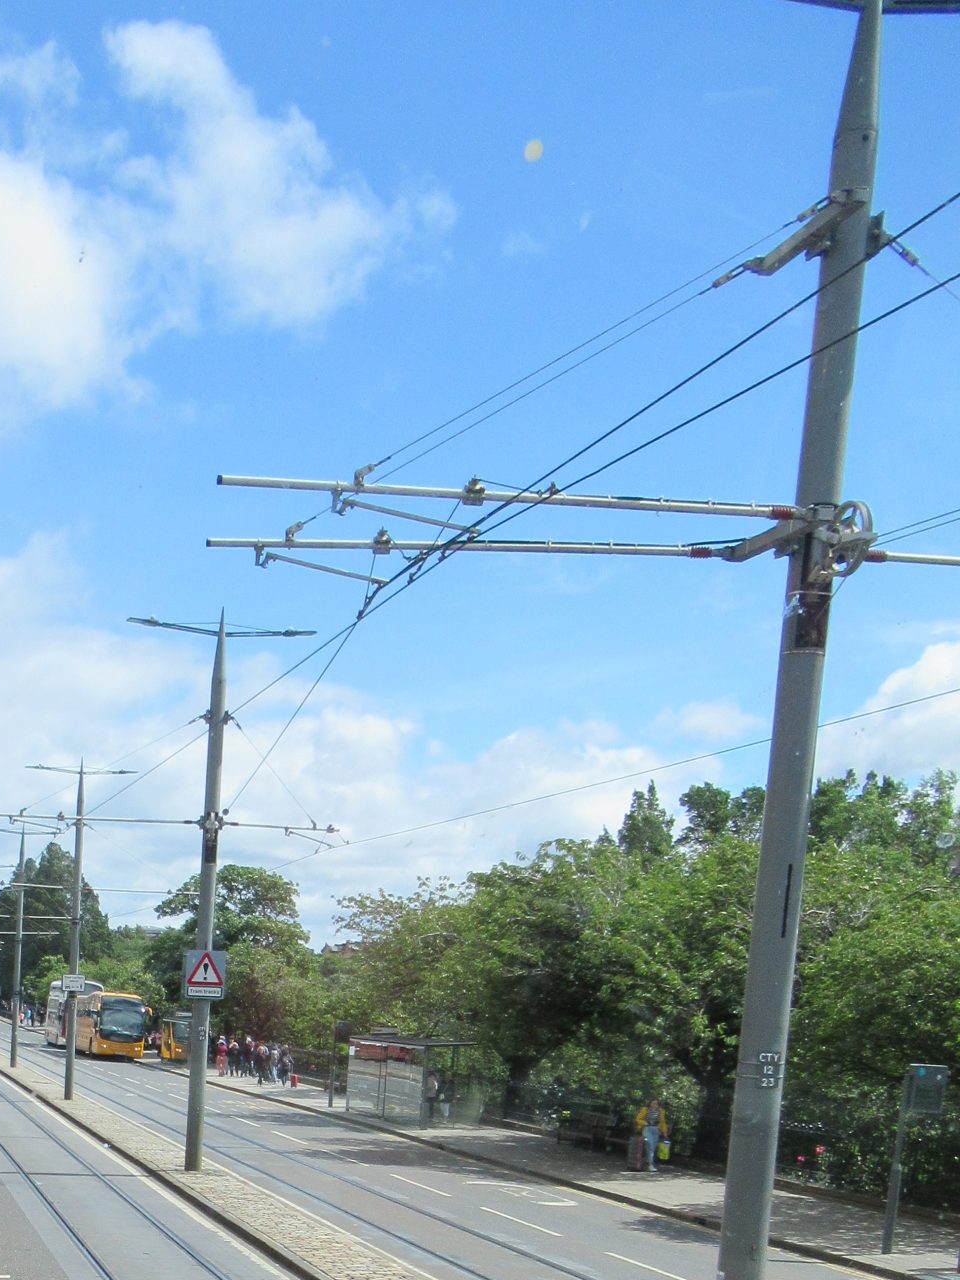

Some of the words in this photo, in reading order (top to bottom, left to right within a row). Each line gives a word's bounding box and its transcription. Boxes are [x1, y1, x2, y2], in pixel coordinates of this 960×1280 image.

[759, 1053, 779, 1062] CTY
[763, 1065, 774, 1074] 12
[761, 1078, 775, 1087] 23
